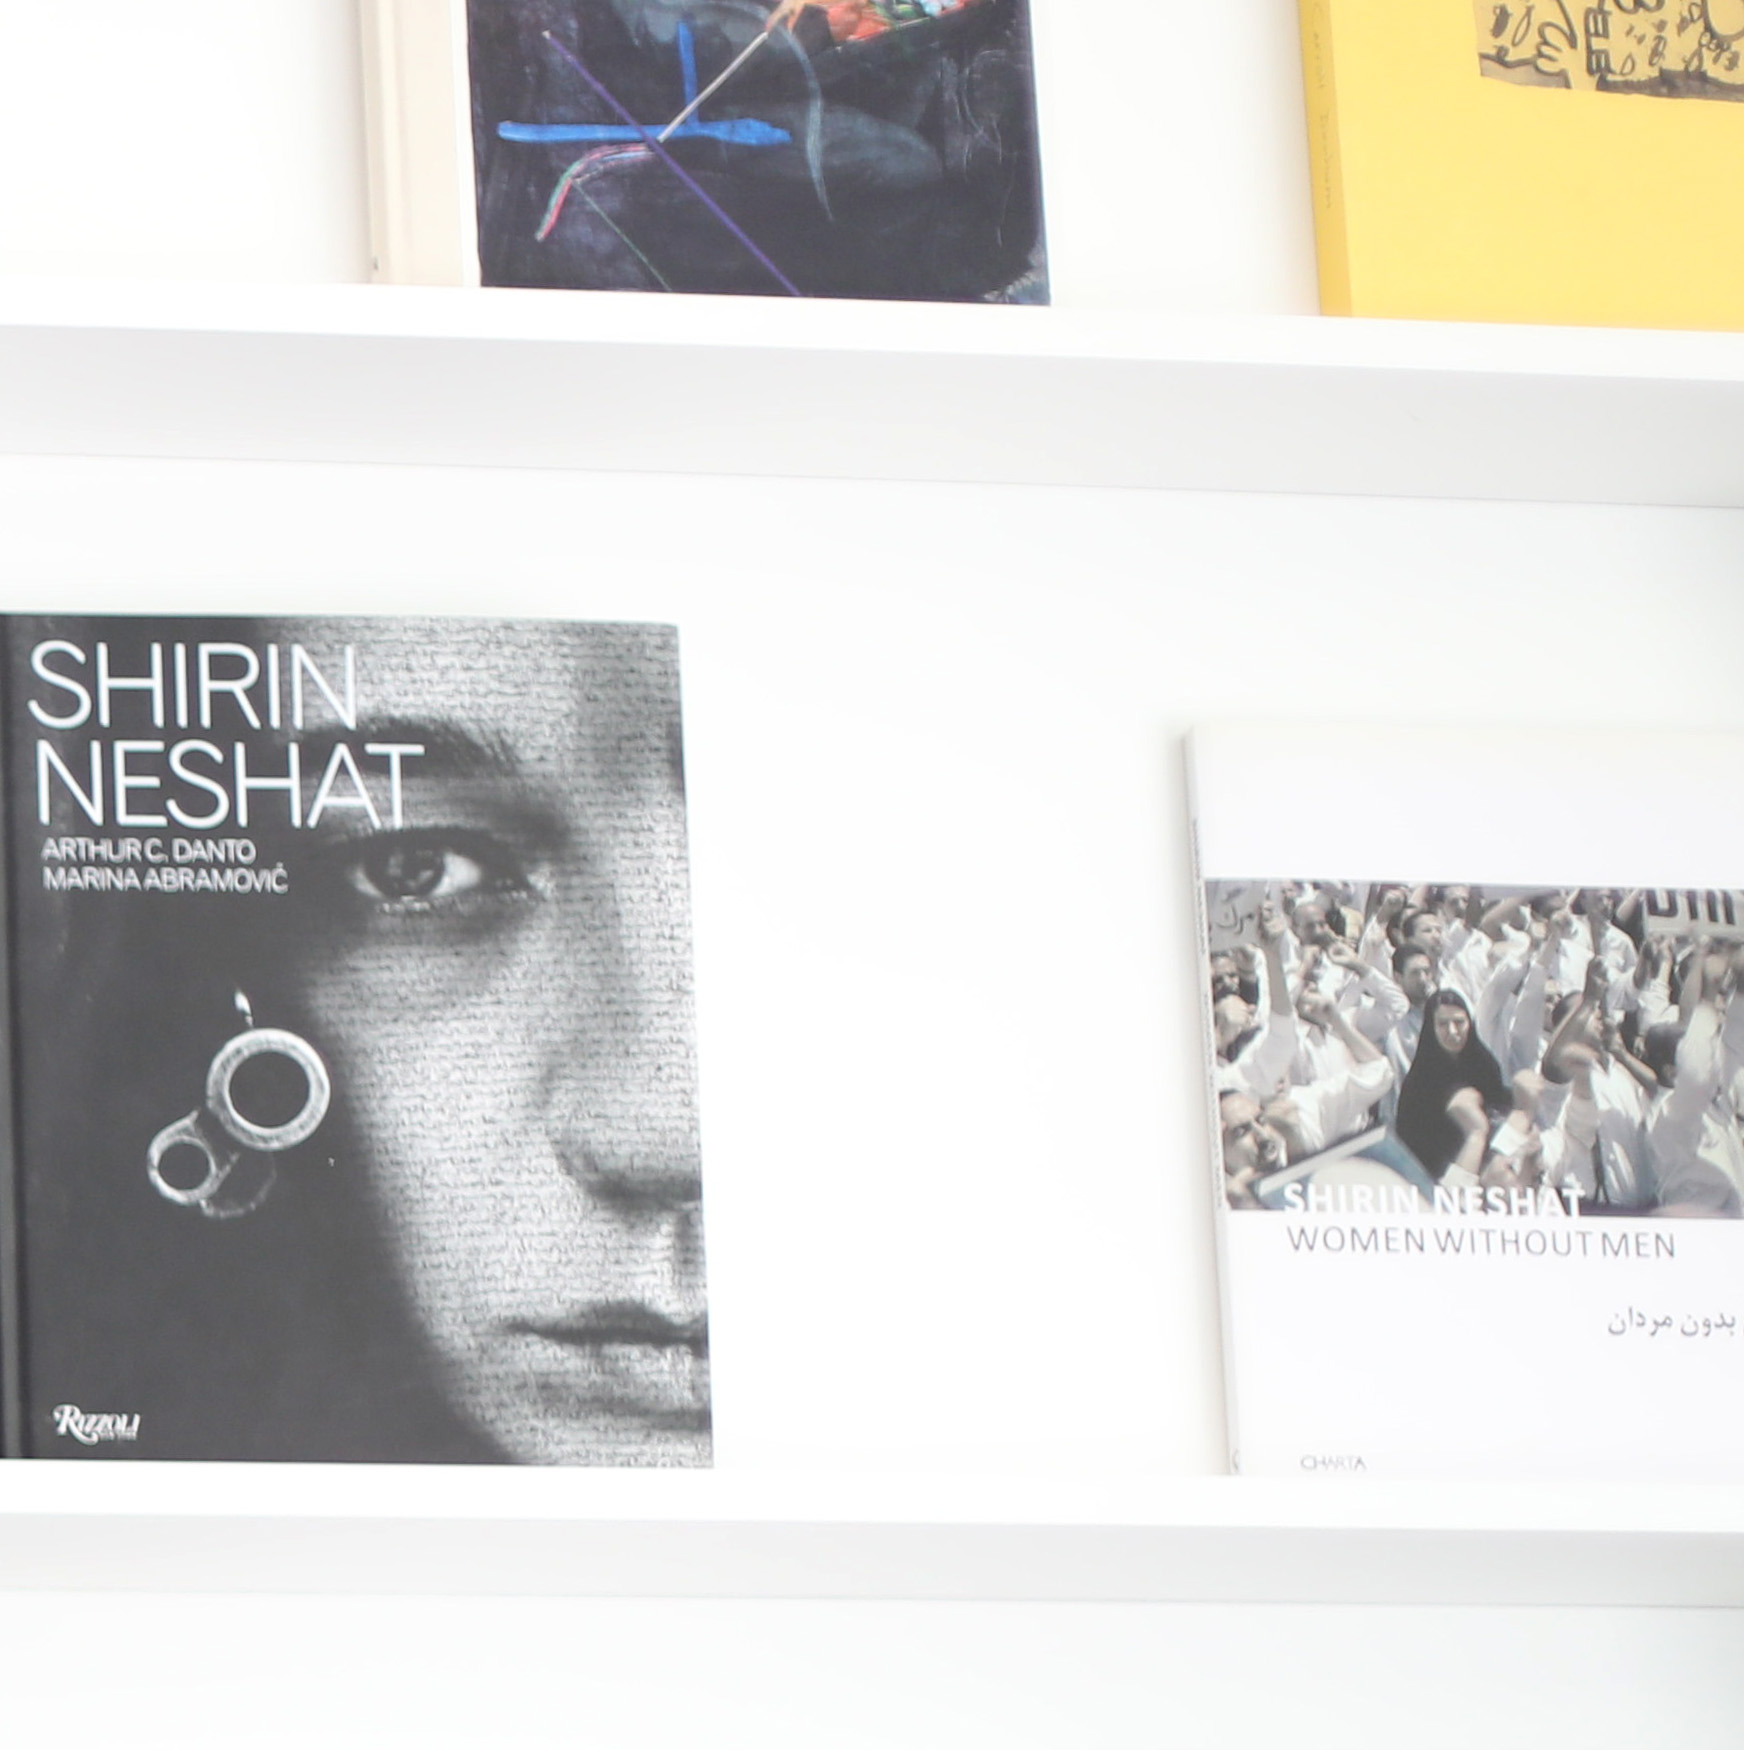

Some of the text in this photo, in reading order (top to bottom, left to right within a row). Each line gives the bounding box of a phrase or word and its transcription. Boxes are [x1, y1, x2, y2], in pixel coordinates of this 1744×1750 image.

[27, 639, 359, 730] SHIRIN
[36, 738, 426, 829] NESHAT
[41, 836, 142, 863] ARTHUR
[172, 838, 257, 864] DANTO
[43, 867, 140, 892] MARINA
[1283, 1183, 1586, 1219] SHIRIN NESHAT
[1287, 1226, 1676, 1259] WOMEN WITHOUT MEN
[1607, 1304, 1674, 1336] مردان
[1679, 1310, 1738, 1337] بدون
